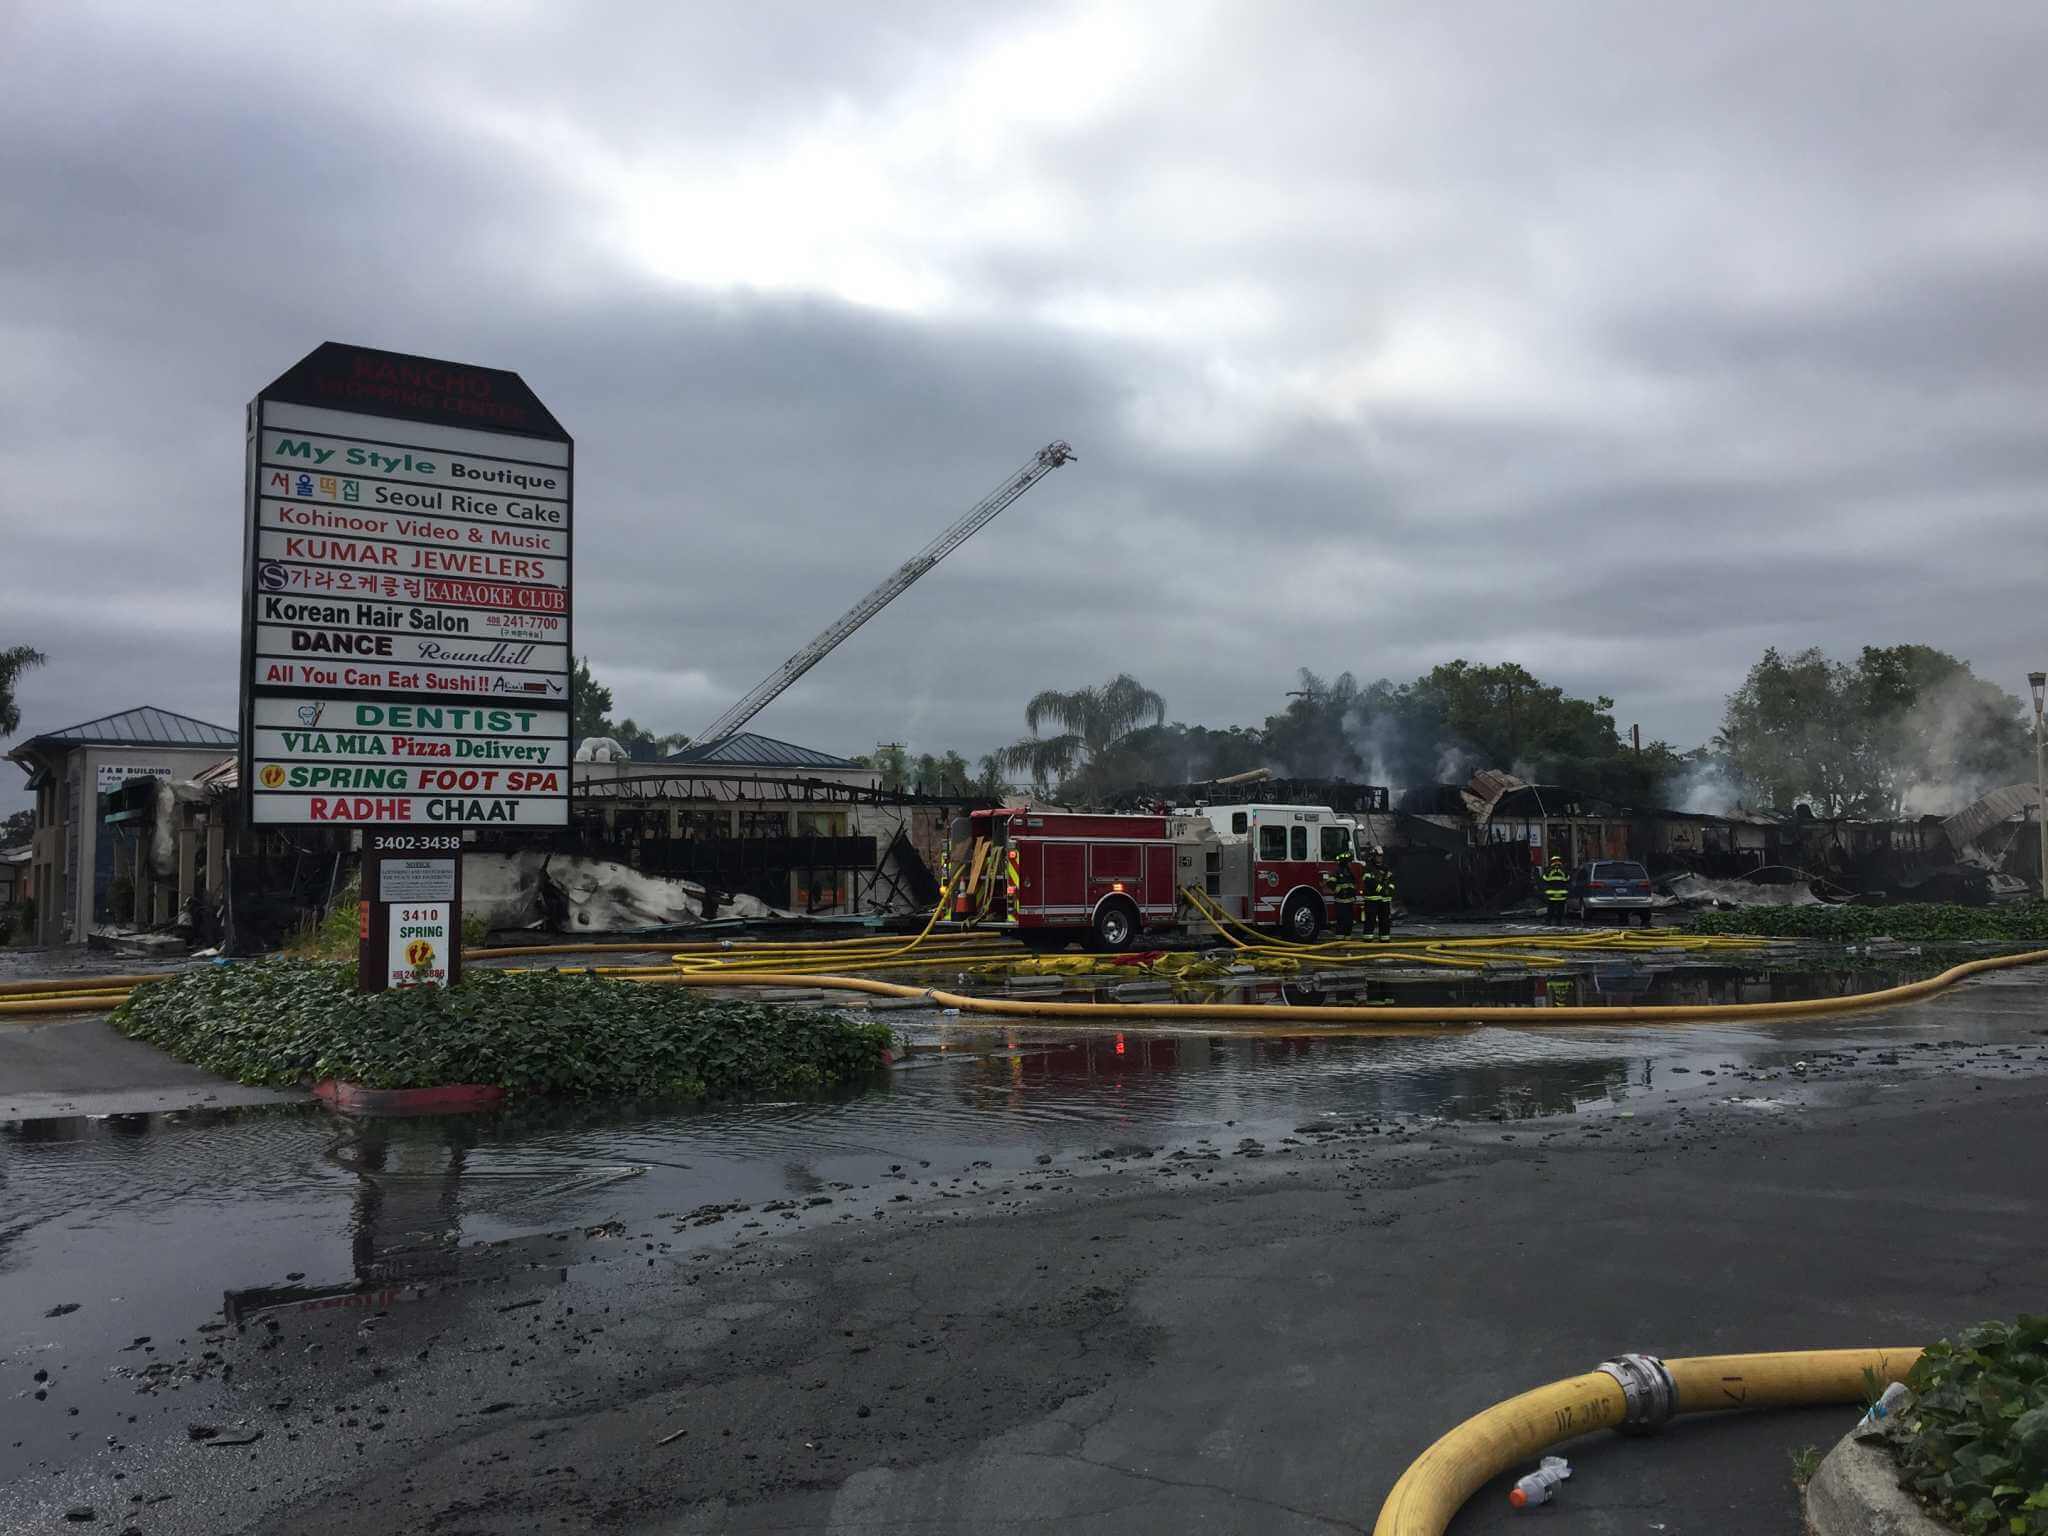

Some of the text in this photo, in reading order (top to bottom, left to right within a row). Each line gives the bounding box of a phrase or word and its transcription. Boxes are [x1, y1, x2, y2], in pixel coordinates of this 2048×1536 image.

[353, 357, 491, 397] RANCHO
[275, 439, 557, 491] My Style Boutique
[271, 471, 561, 524] 서울떡집 Seoul Rice Cake
[279, 506, 551, 550] Kohinoor Video & Music
[286, 537, 545, 579] KUMAR JEWELERS
[291, 569, 422, 598] 가라오케클럽
[427, 581, 513, 606] KARAOKE
[519, 591, 565, 610] CLUB
[265, 597, 470, 633] Korean Hair Salon
[503, 615, 558, 630] 241-7700
[291, 630, 393, 657] DANCE
[418, 641, 536, 666] Roundhill
[267, 665, 293, 684] All
[301, 666, 338, 685] You
[344, 669, 381, 687] Can
[389, 671, 419, 689] Eat
[426, 673, 489, 693] Sushi!!
[355, 705, 538, 732] DENTIST
[281, 733, 551, 763] VIA MIA Pizza Delivery
[288, 767, 559, 792] SPRING FOOT SPA
[310, 798, 519, 822] RADHE CHAAT
[374, 836, 460, 850] 3402-3438
[402, 910, 438, 922] 3410
[400, 926, 443, 938] SPRING
